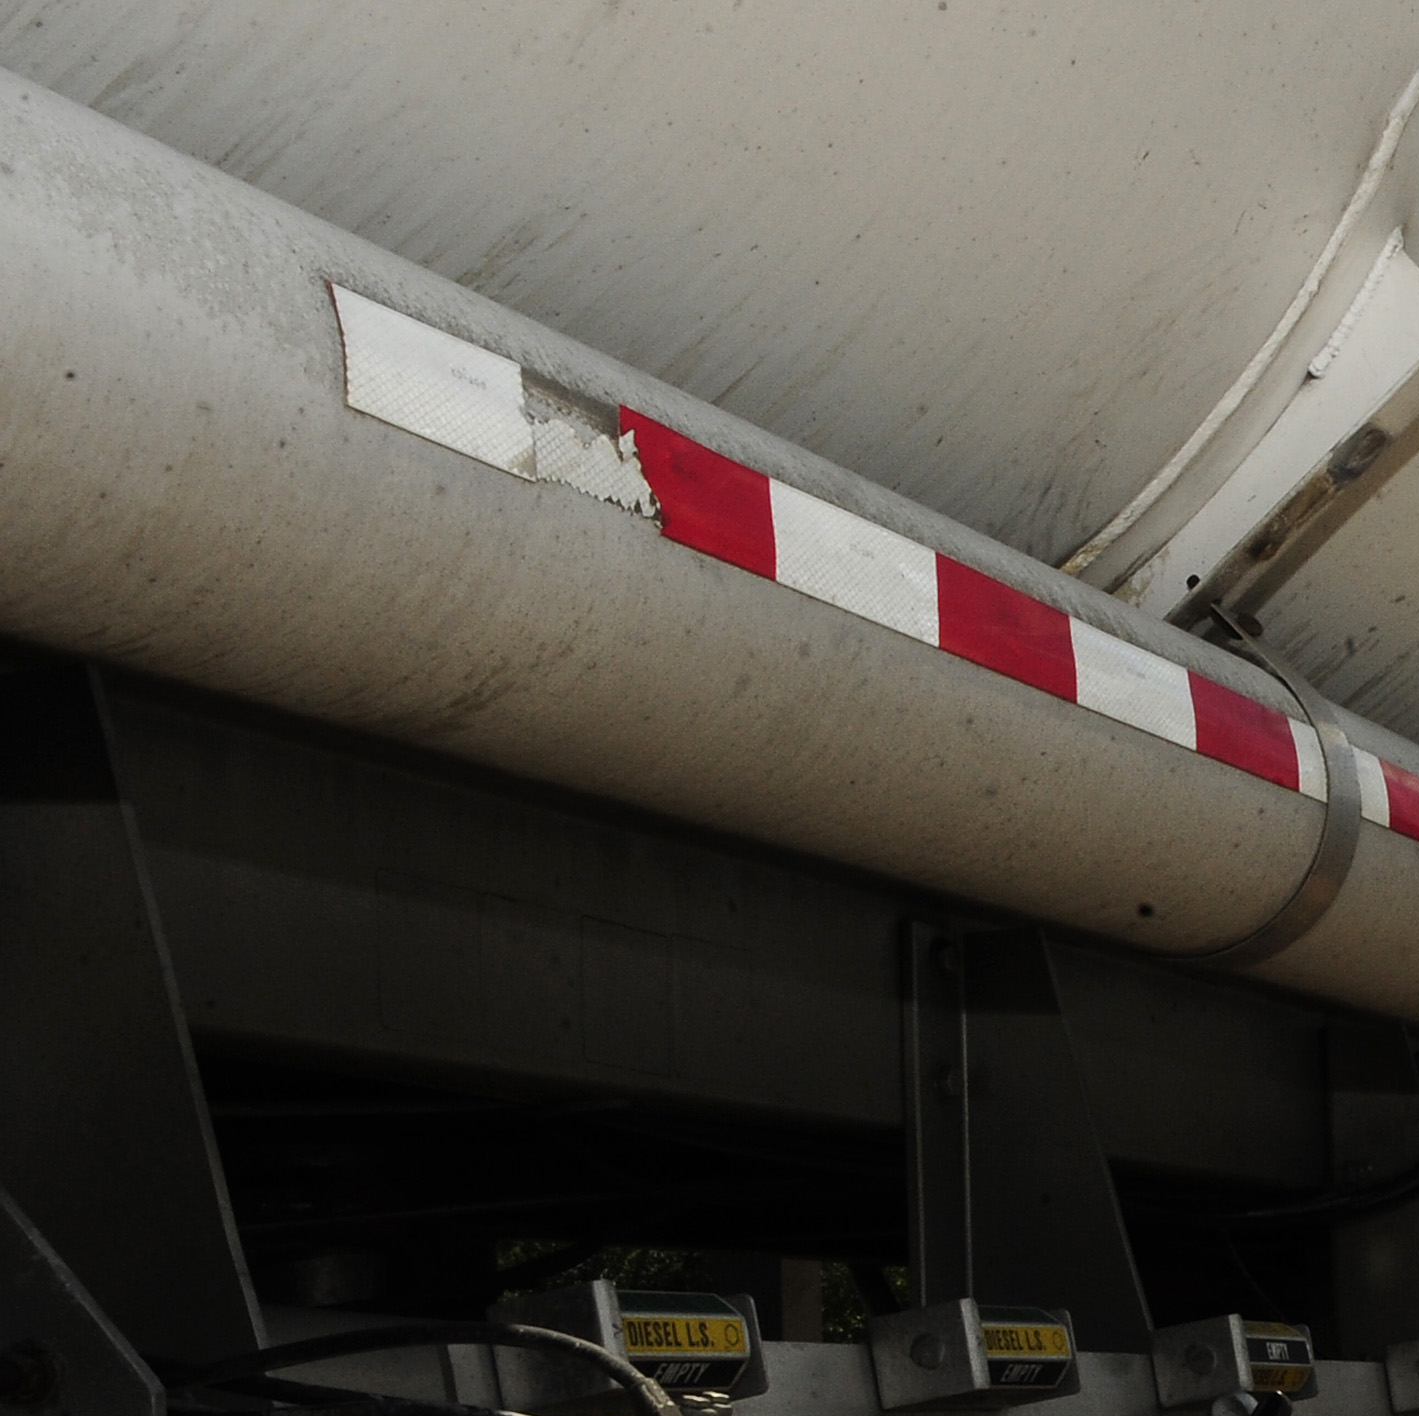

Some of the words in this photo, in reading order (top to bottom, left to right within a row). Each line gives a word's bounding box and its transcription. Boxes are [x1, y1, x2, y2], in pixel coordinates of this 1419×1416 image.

[628, 1321, 682, 1347] DIESEL
[685, 1322, 715, 1347] L.S.
[984, 1329, 1023, 1350] DIESEL
[1025, 1330, 1047, 1351] L.S.
[1266, 1342, 1290, 1360] EMPTY
[654, 1362, 711, 1385] EMPTY
[1000, 1363, 1044, 1383] EMPTY
